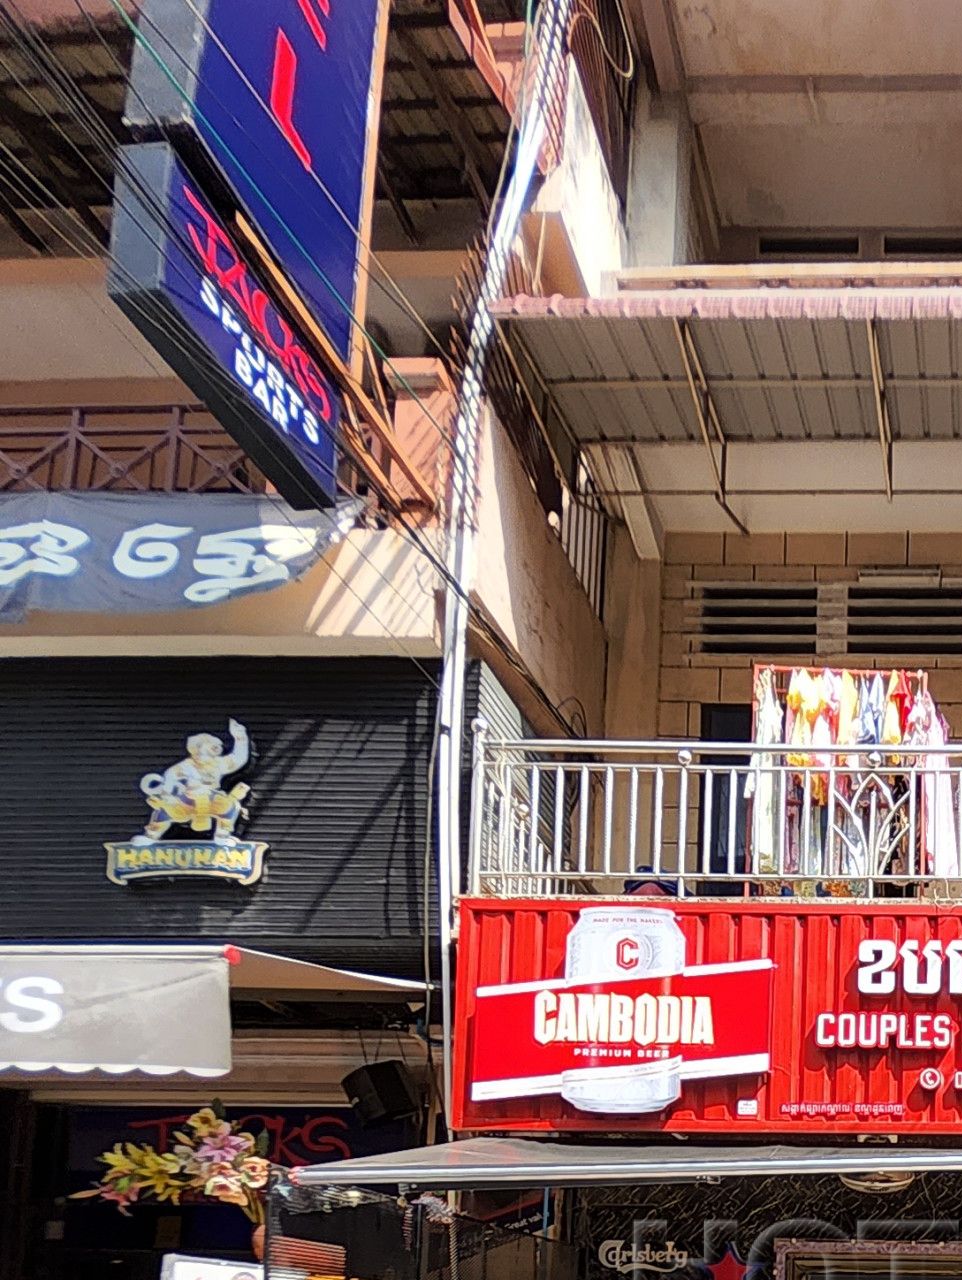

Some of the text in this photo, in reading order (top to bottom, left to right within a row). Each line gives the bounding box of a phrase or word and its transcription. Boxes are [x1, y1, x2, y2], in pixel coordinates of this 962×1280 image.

[200, 274, 320, 446] SPORTS
[234, 346, 290, 436] BAR
[116, 846, 251, 870] HANUMAN
[616, 937, 639, 970] C
[533, 989, 715, 1046] CAMBODIA
[816, 1012, 952, 1048] COUPLES
[573, 1047, 670, 1059] PREMIUM BEER
[598, 1239, 688, 1275] Carlsberg
